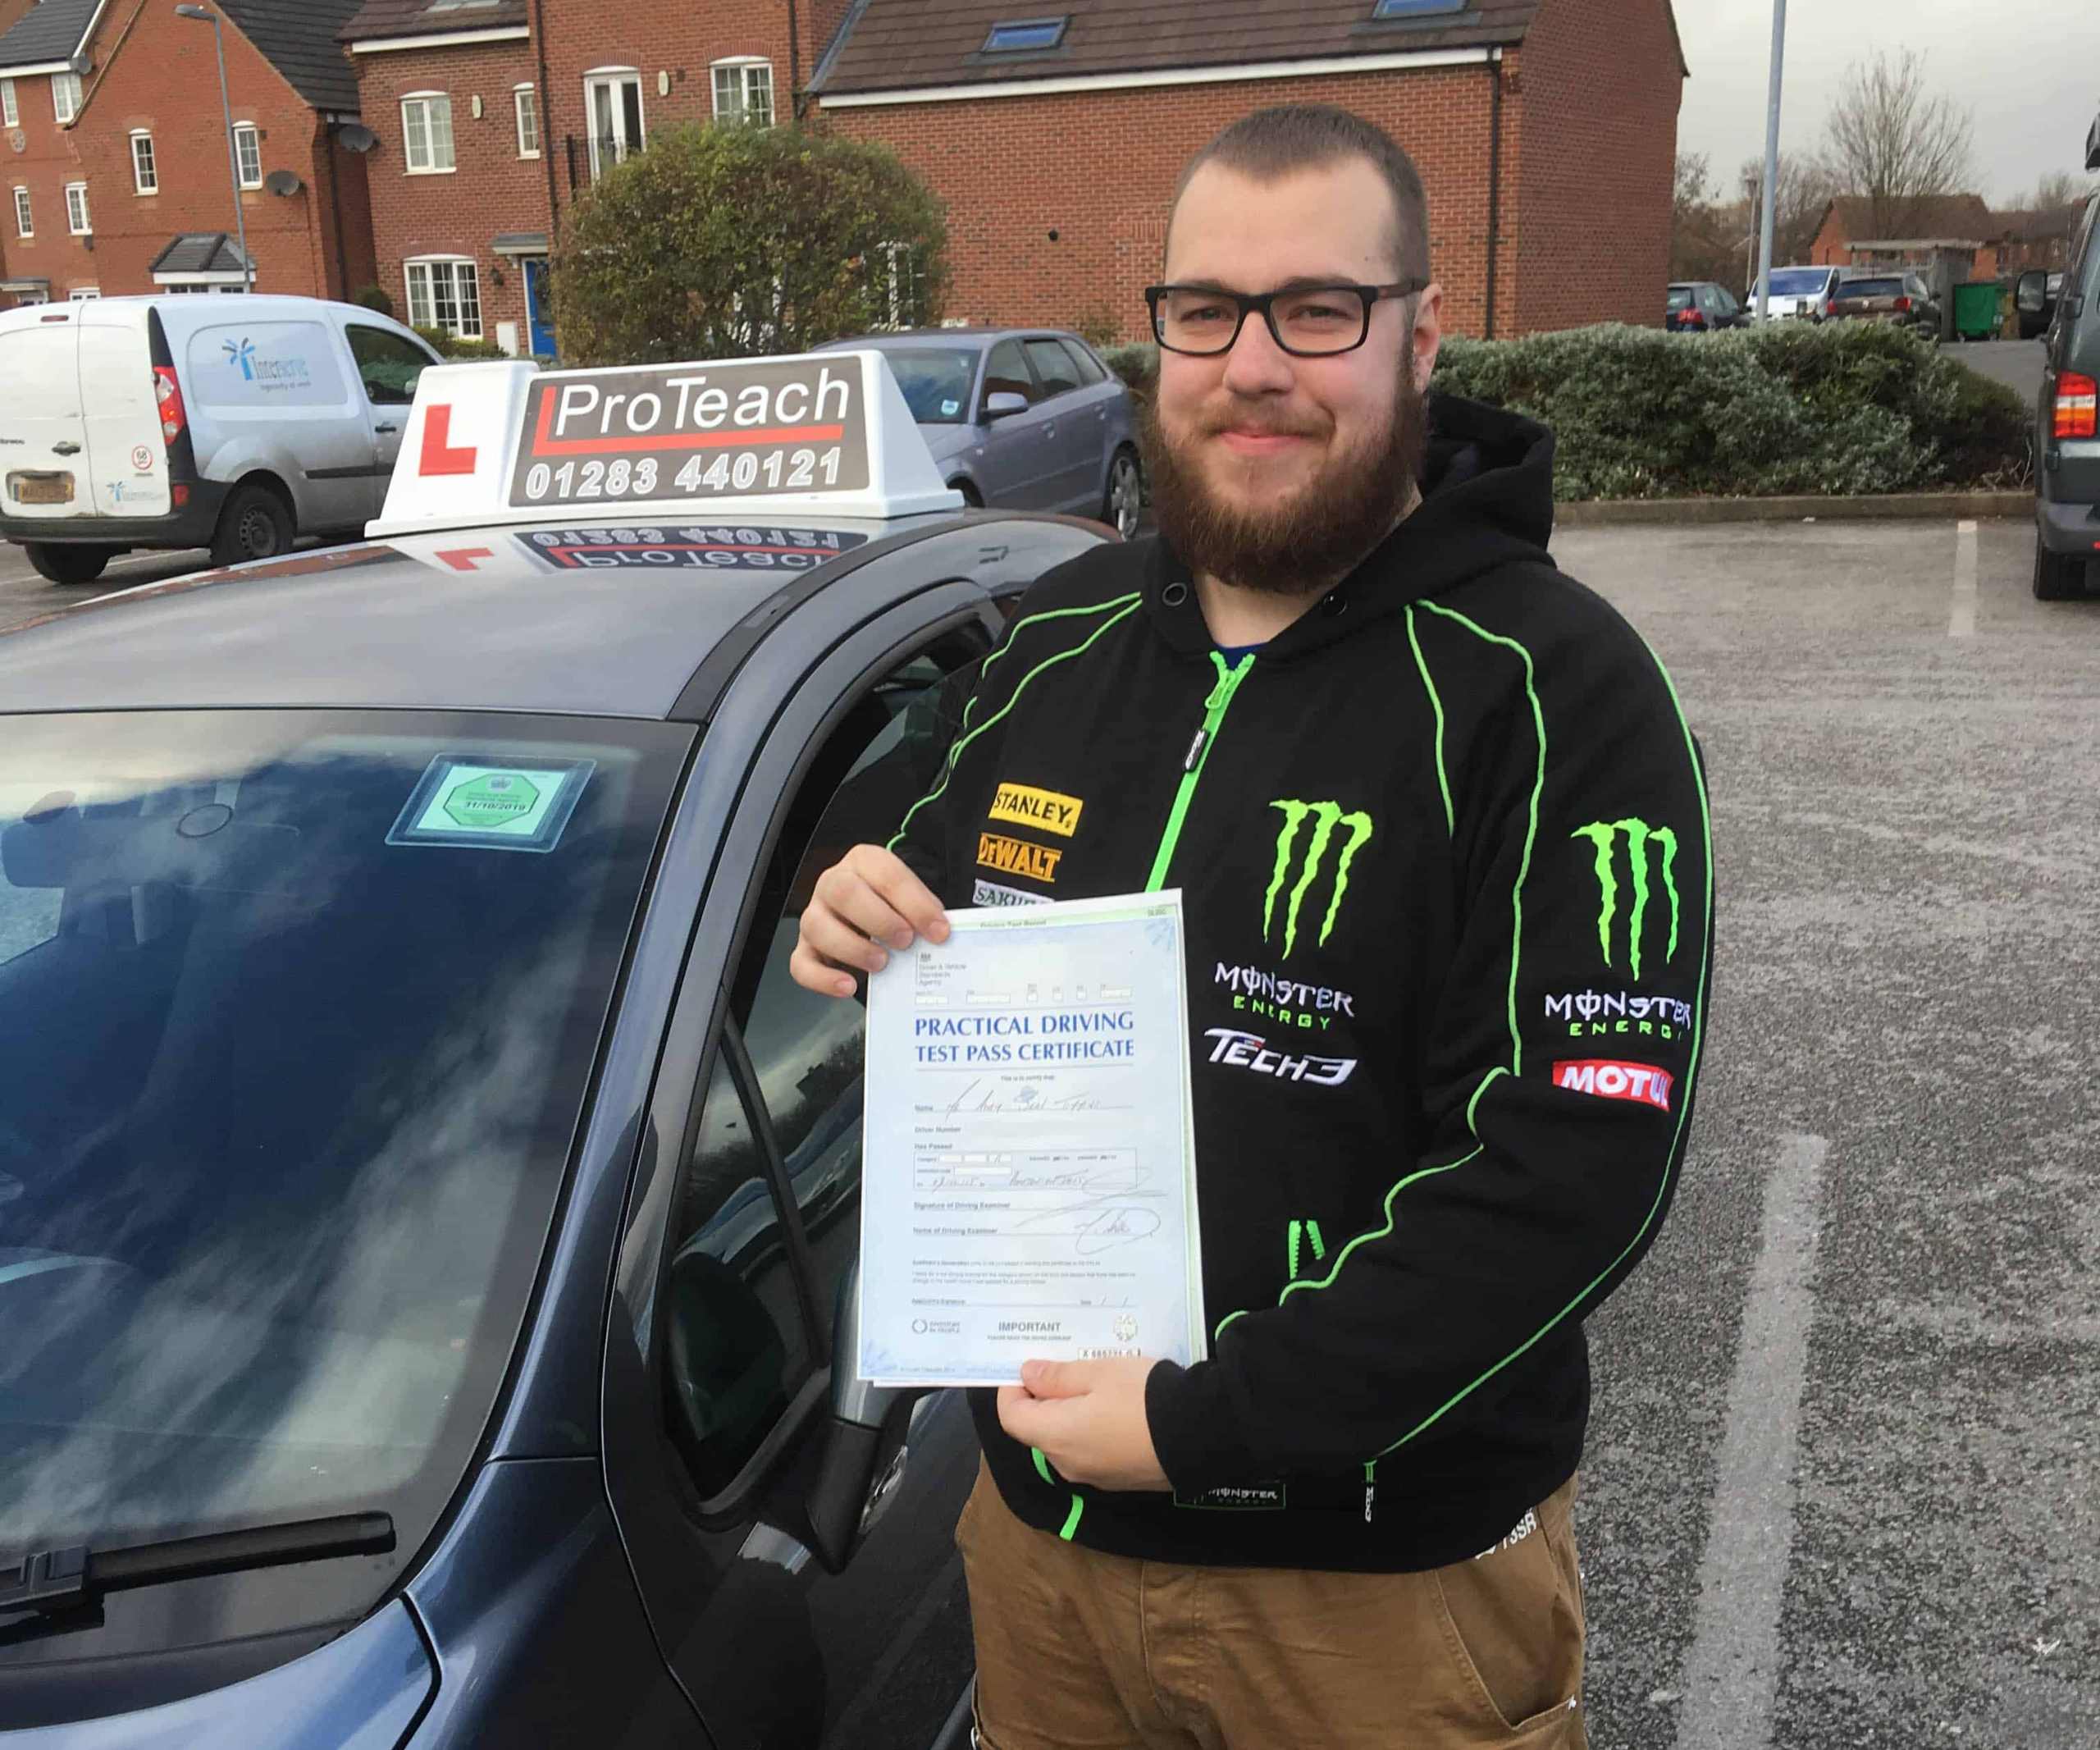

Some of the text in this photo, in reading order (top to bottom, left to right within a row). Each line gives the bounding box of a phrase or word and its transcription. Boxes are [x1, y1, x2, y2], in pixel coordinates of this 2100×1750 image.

[555, 368, 849, 436] ProTeach
[418, 404, 477, 476] L
[526, 447, 842, 499] 01283 440121
[993, 792, 1073, 825] STANLEY
[1215, 962, 1354, 1017] MONSTER
[915, 1011, 1134, 1036] PRACTICAL DRIVING
[1233, 994, 1331, 1030] ENERGY
[1545, 989, 1691, 1030] MONSTER
[915, 1039, 1134, 1062] TEST PASS CERTIFICATE
[998, 1322, 1061, 1332] IMPORTANT
